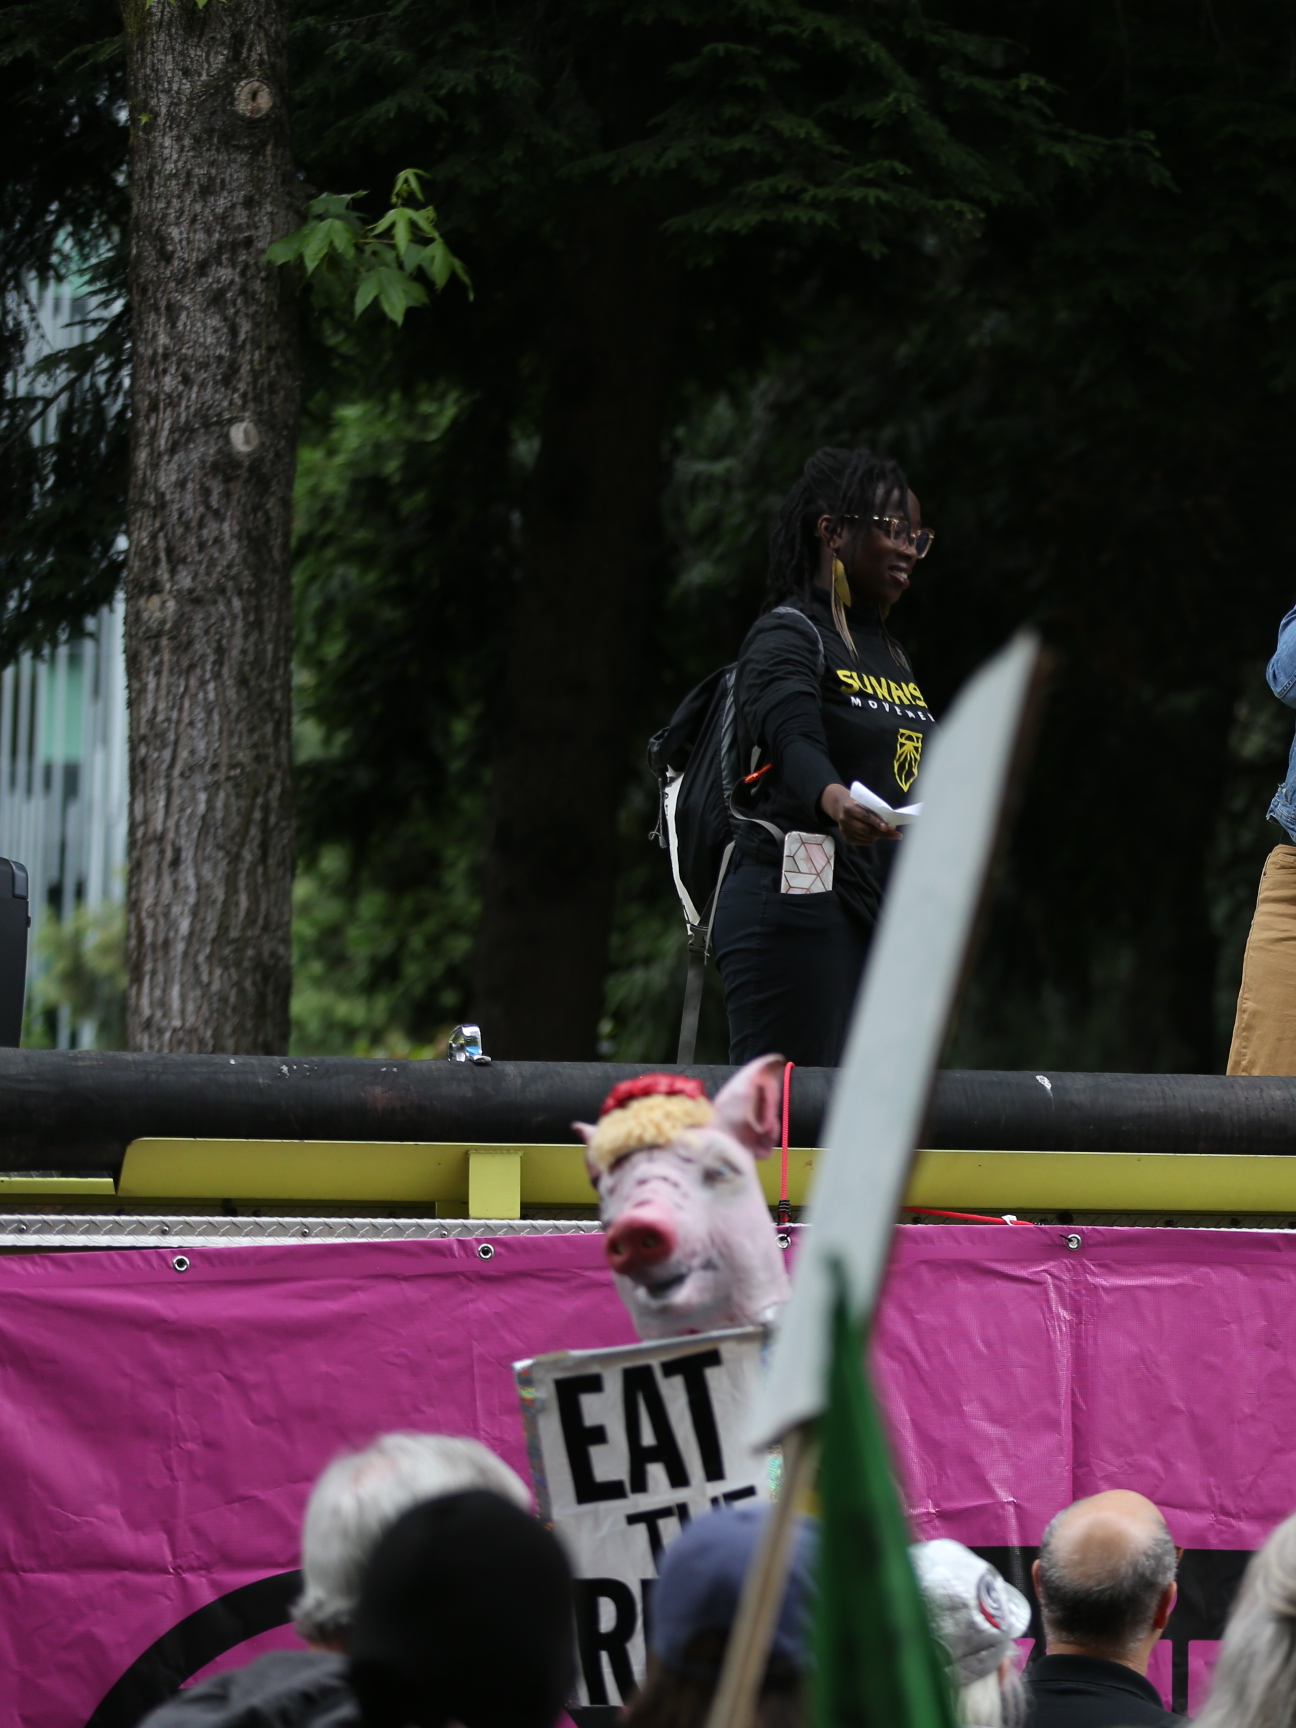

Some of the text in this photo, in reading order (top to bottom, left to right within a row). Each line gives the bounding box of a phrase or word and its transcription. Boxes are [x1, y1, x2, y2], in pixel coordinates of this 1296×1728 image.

[836, 669, 929, 709] SUNRIS
[851, 696, 935, 722] MOVEME
[554, 1349, 725, 1505] EAT
